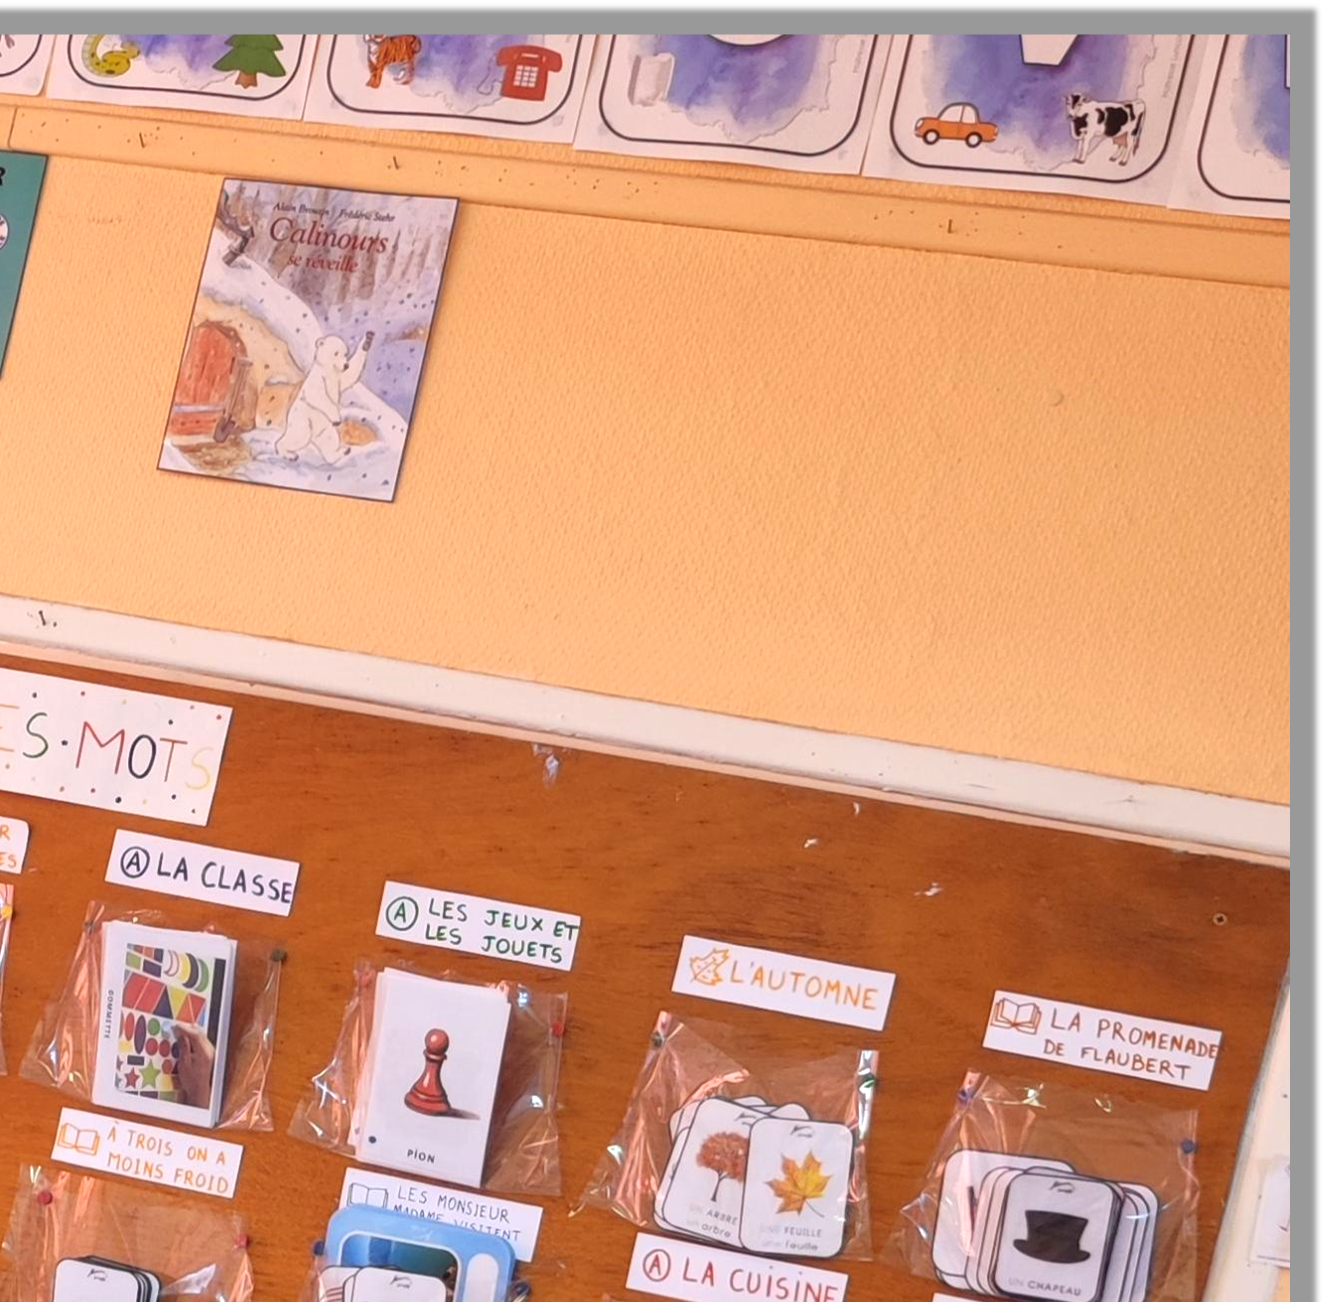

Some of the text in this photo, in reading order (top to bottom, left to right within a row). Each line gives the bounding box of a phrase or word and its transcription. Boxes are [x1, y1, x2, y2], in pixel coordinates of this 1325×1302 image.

[270, 217, 388, 254] Calinours
[288, 255, 358, 273] se réveille
[74, 720, 215, 791] MOTS
[157, 852, 188, 882] LA
[201, 861, 293, 904] CLASSE
[428, 898, 468, 922] LES
[484, 909, 544, 932] JEUX
[552, 921, 580, 941] ET
[426, 924, 563, 964] LES JOUETS
[730, 960, 879, 1011] L'AUTOMNE
[1050, 1007, 1219, 1059] LA PROMENADE
[1043, 1039, 1191, 1081] DE FLAUBERT
[128, 1130, 173, 1156] TROIS
[187, 1146, 208, 1162] ON
[216, 1152, 226, 1166] A
[407, 1148, 436, 1164] PION
[107, 1152, 230, 1194] MOINS FROID
[398, 1185, 510, 1224] LES MONSIEUR
[707, 1209, 738, 1226] ARBRE
[701, 1223, 731, 1238] arbre
[784, 1226, 822, 1238] FEUILLE
[785, 1239, 818, 1251] feuille
[682, 1257, 715, 1287] LA
[1027, 1280, 1082, 1297] CHAPEAU
